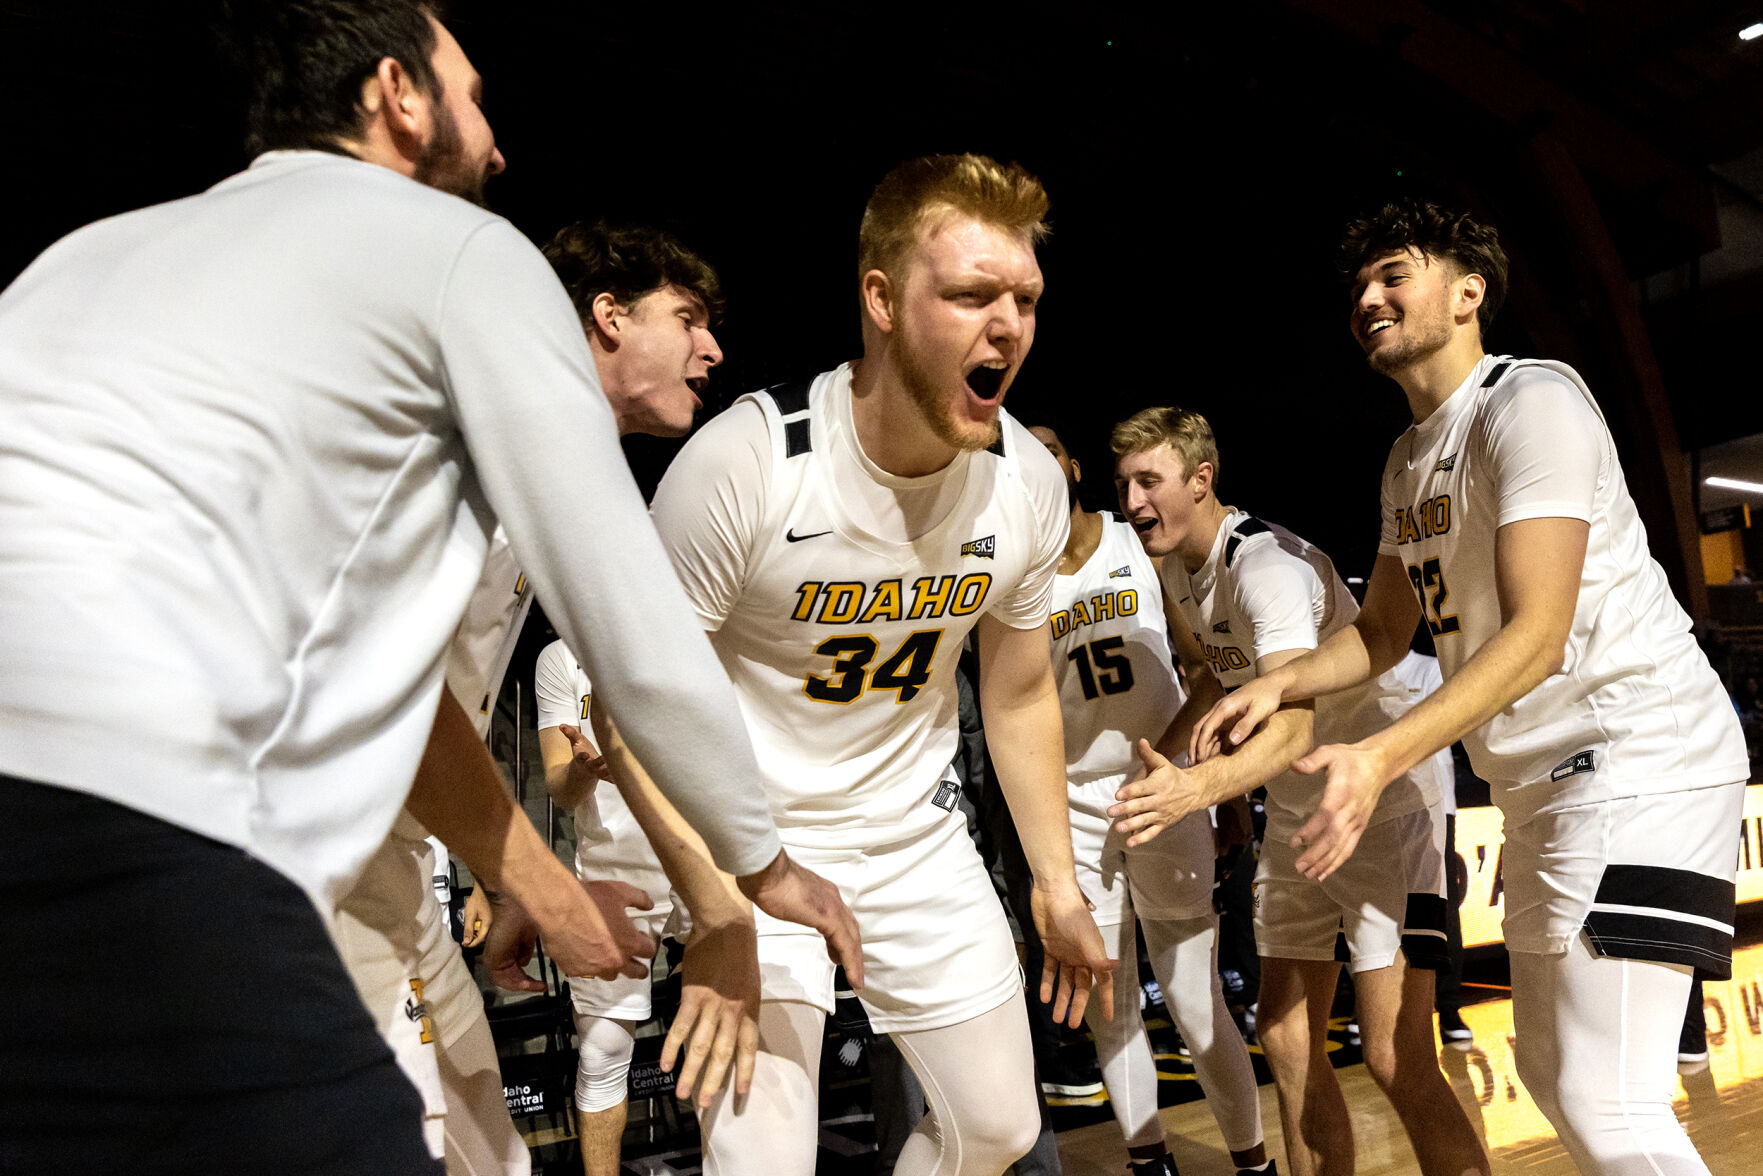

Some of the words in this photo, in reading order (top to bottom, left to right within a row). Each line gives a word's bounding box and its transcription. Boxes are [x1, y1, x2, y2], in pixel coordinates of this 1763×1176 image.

[1395, 494, 1451, 545] DAHO
[790, 572, 993, 624] IDAHO
[1050, 589, 1139, 641] DAHO
[802, 628, 945, 705] 34
[1068, 634, 1135, 701] 15
[1576, 757, 1590, 767] XL
[630, 1066, 662, 1079] Idaho
[632, 1072, 674, 1089] Central
[503, 1085, 531, 1098] daho
[506, 1092, 544, 1108] entral
[524, 1105, 544, 1113] UNION
